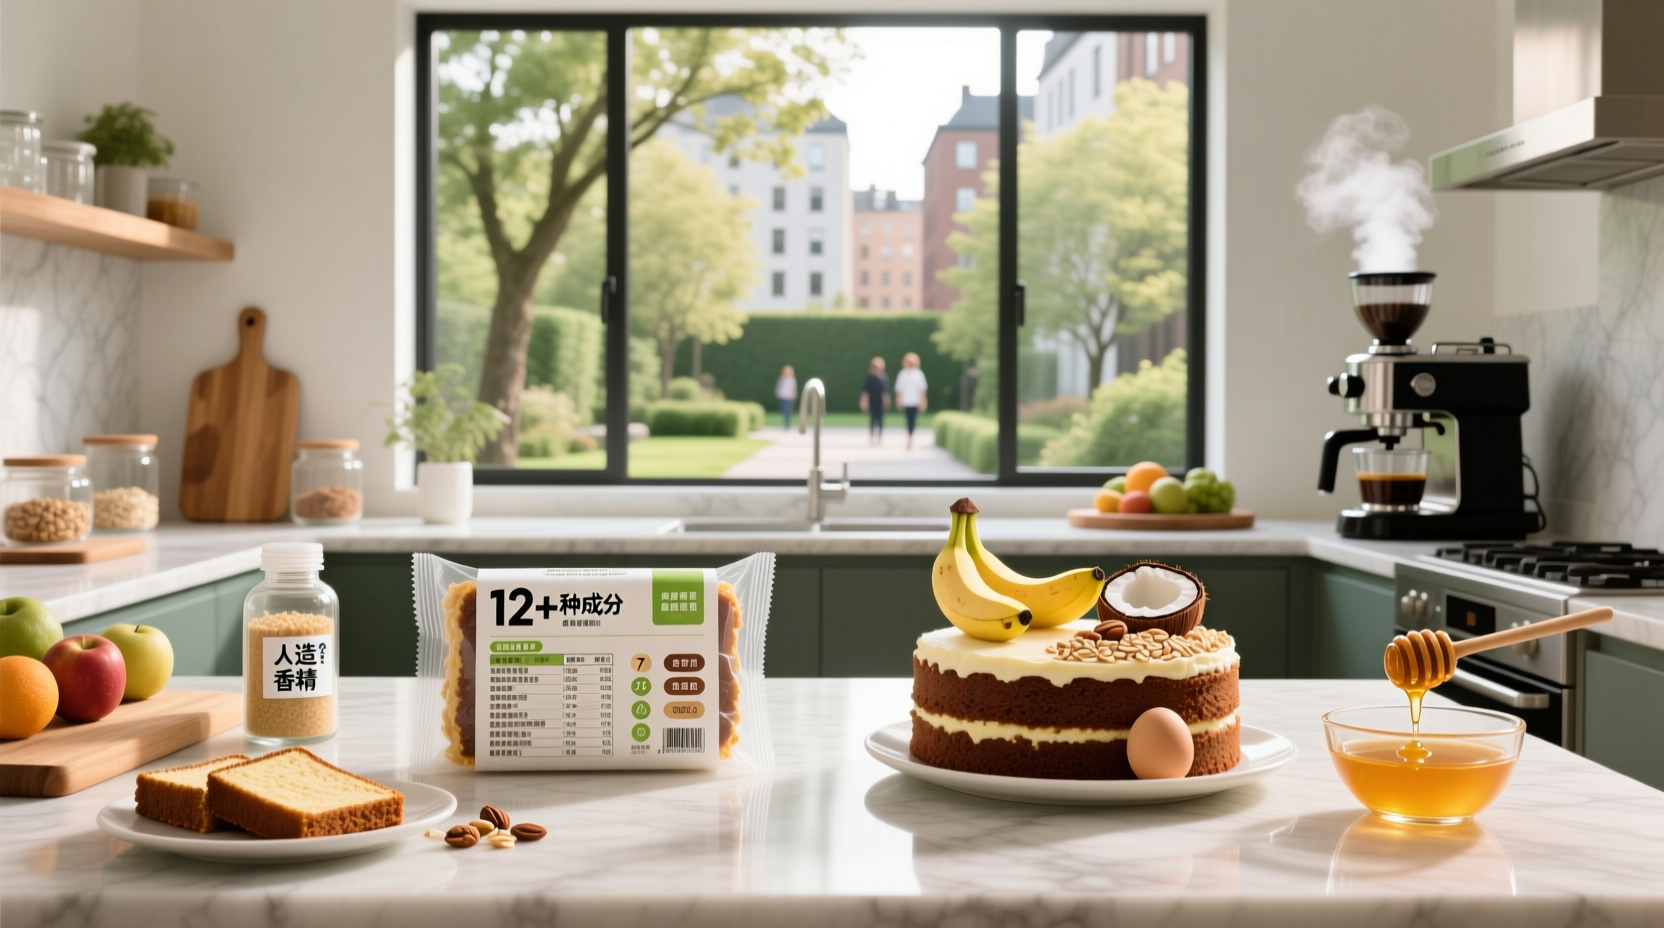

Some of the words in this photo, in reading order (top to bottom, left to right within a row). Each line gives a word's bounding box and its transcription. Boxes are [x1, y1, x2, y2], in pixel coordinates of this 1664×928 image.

[490, 587, 624, 627] 12+种成分
[273, 667, 318, 692] 香精
